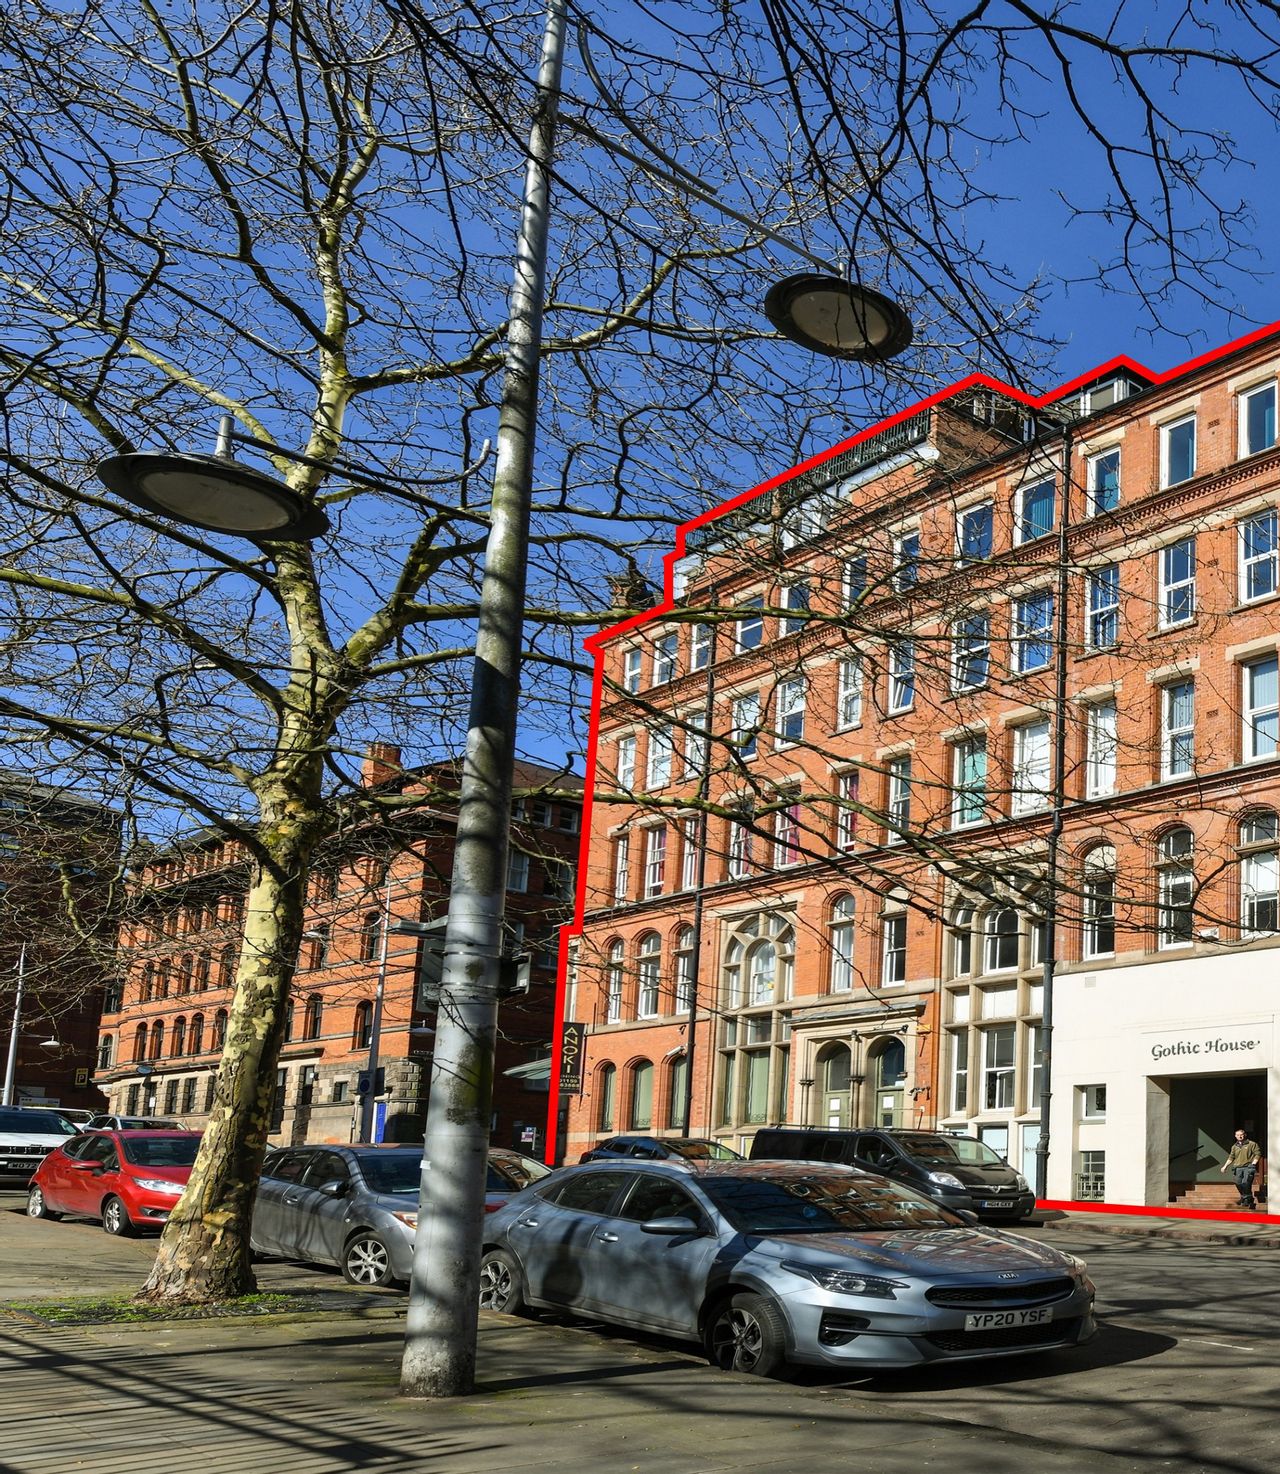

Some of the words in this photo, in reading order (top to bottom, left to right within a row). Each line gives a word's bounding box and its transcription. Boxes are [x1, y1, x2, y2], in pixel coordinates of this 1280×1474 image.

[562, 1027, 579, 1073] ANOKI
[1151, 1041, 1200, 1061] Gothic
[1204, 1038, 1261, 1053] House
[973, 1313, 1015, 1328] YP20
[1020, 1309, 1047, 1323] YSF
